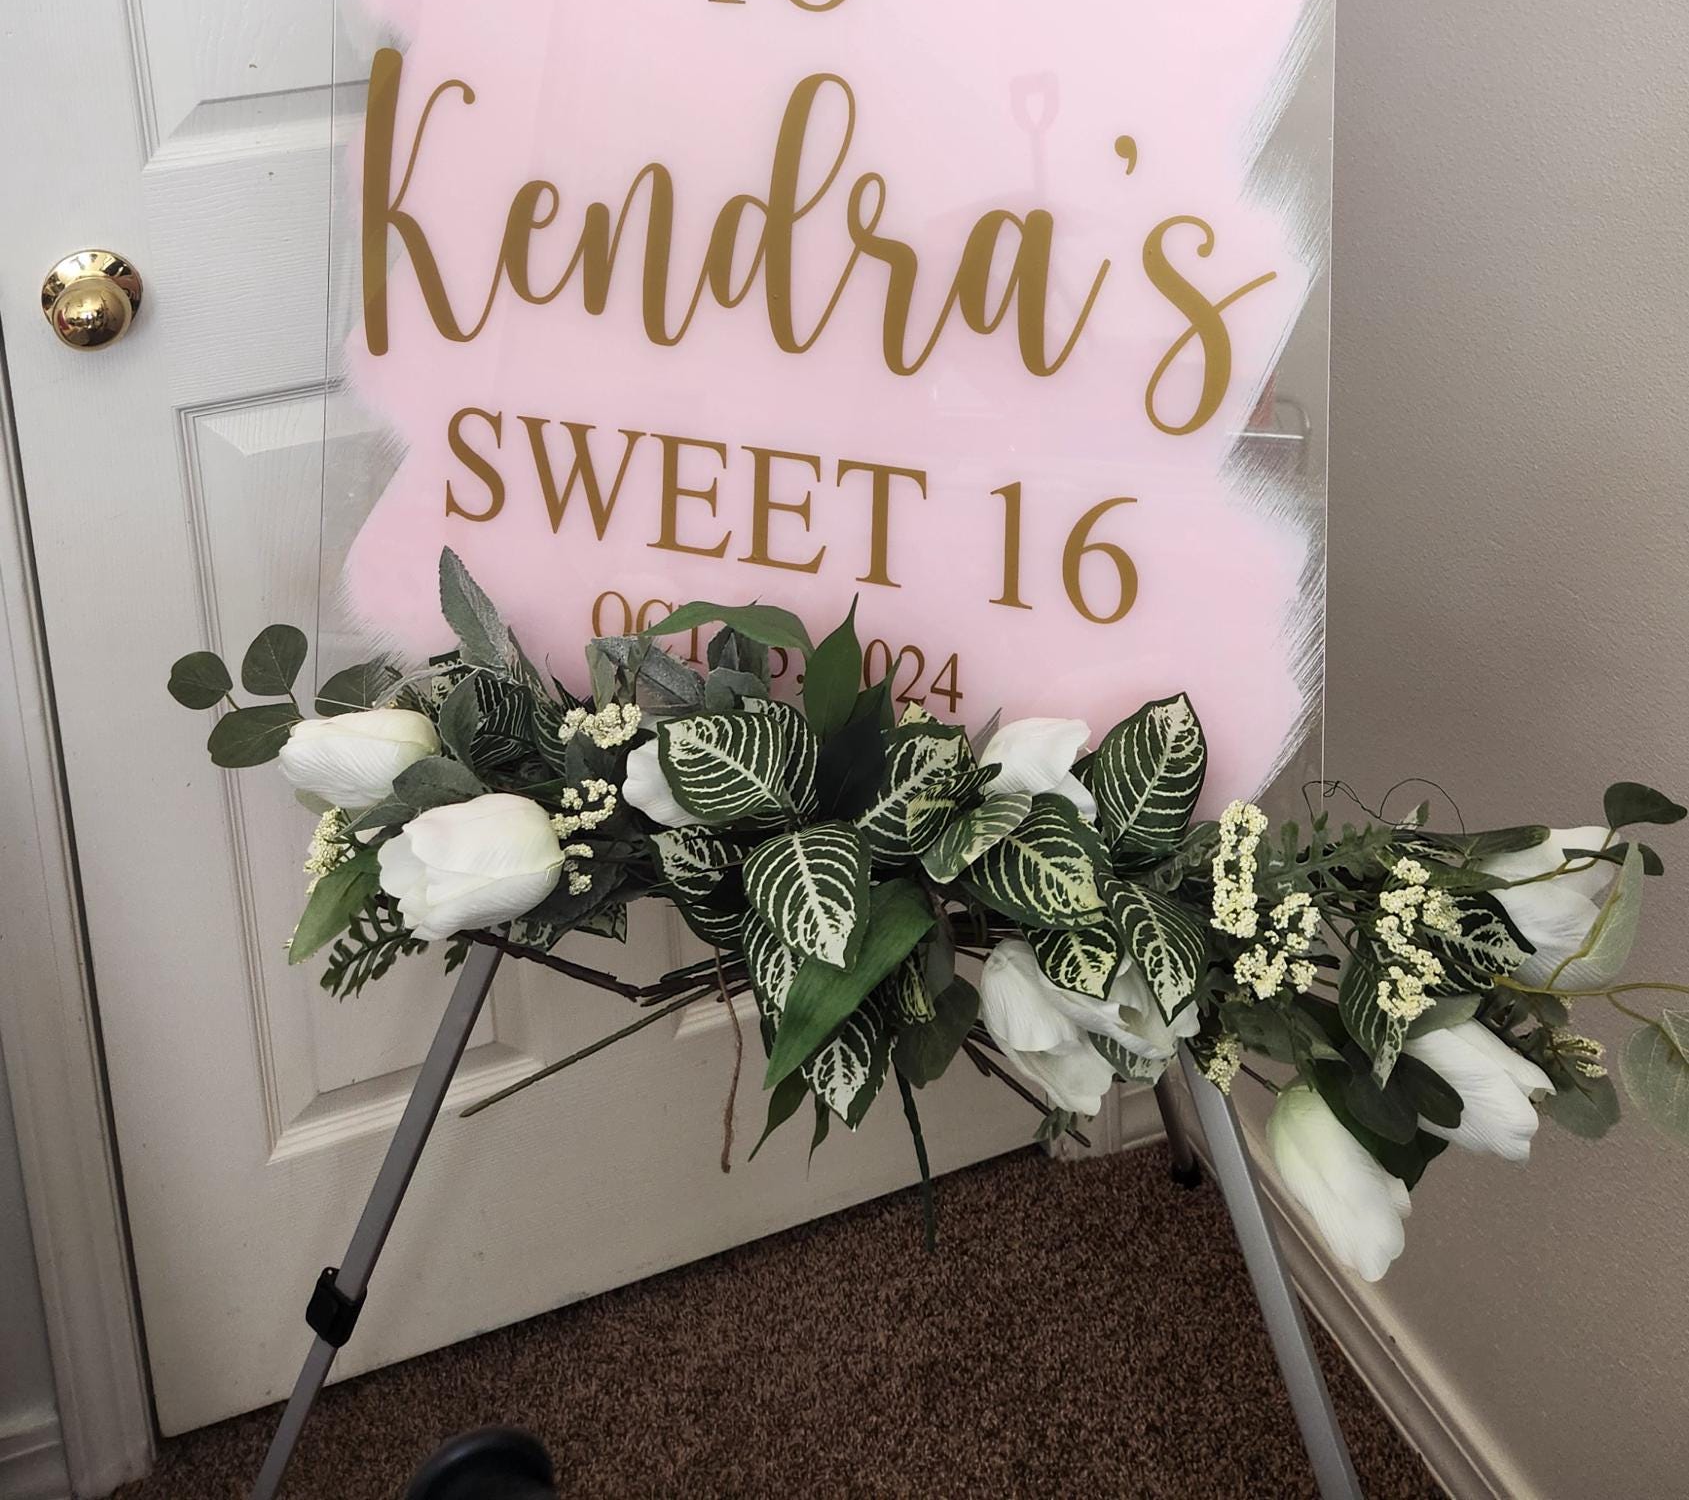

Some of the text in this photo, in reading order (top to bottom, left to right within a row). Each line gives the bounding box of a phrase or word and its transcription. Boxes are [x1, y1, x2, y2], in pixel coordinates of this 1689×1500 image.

[362, 47, 1277, 437] Kendra's
[444, 406, 1140, 625] SWEET 16
[862, 638, 964, 714] 024
